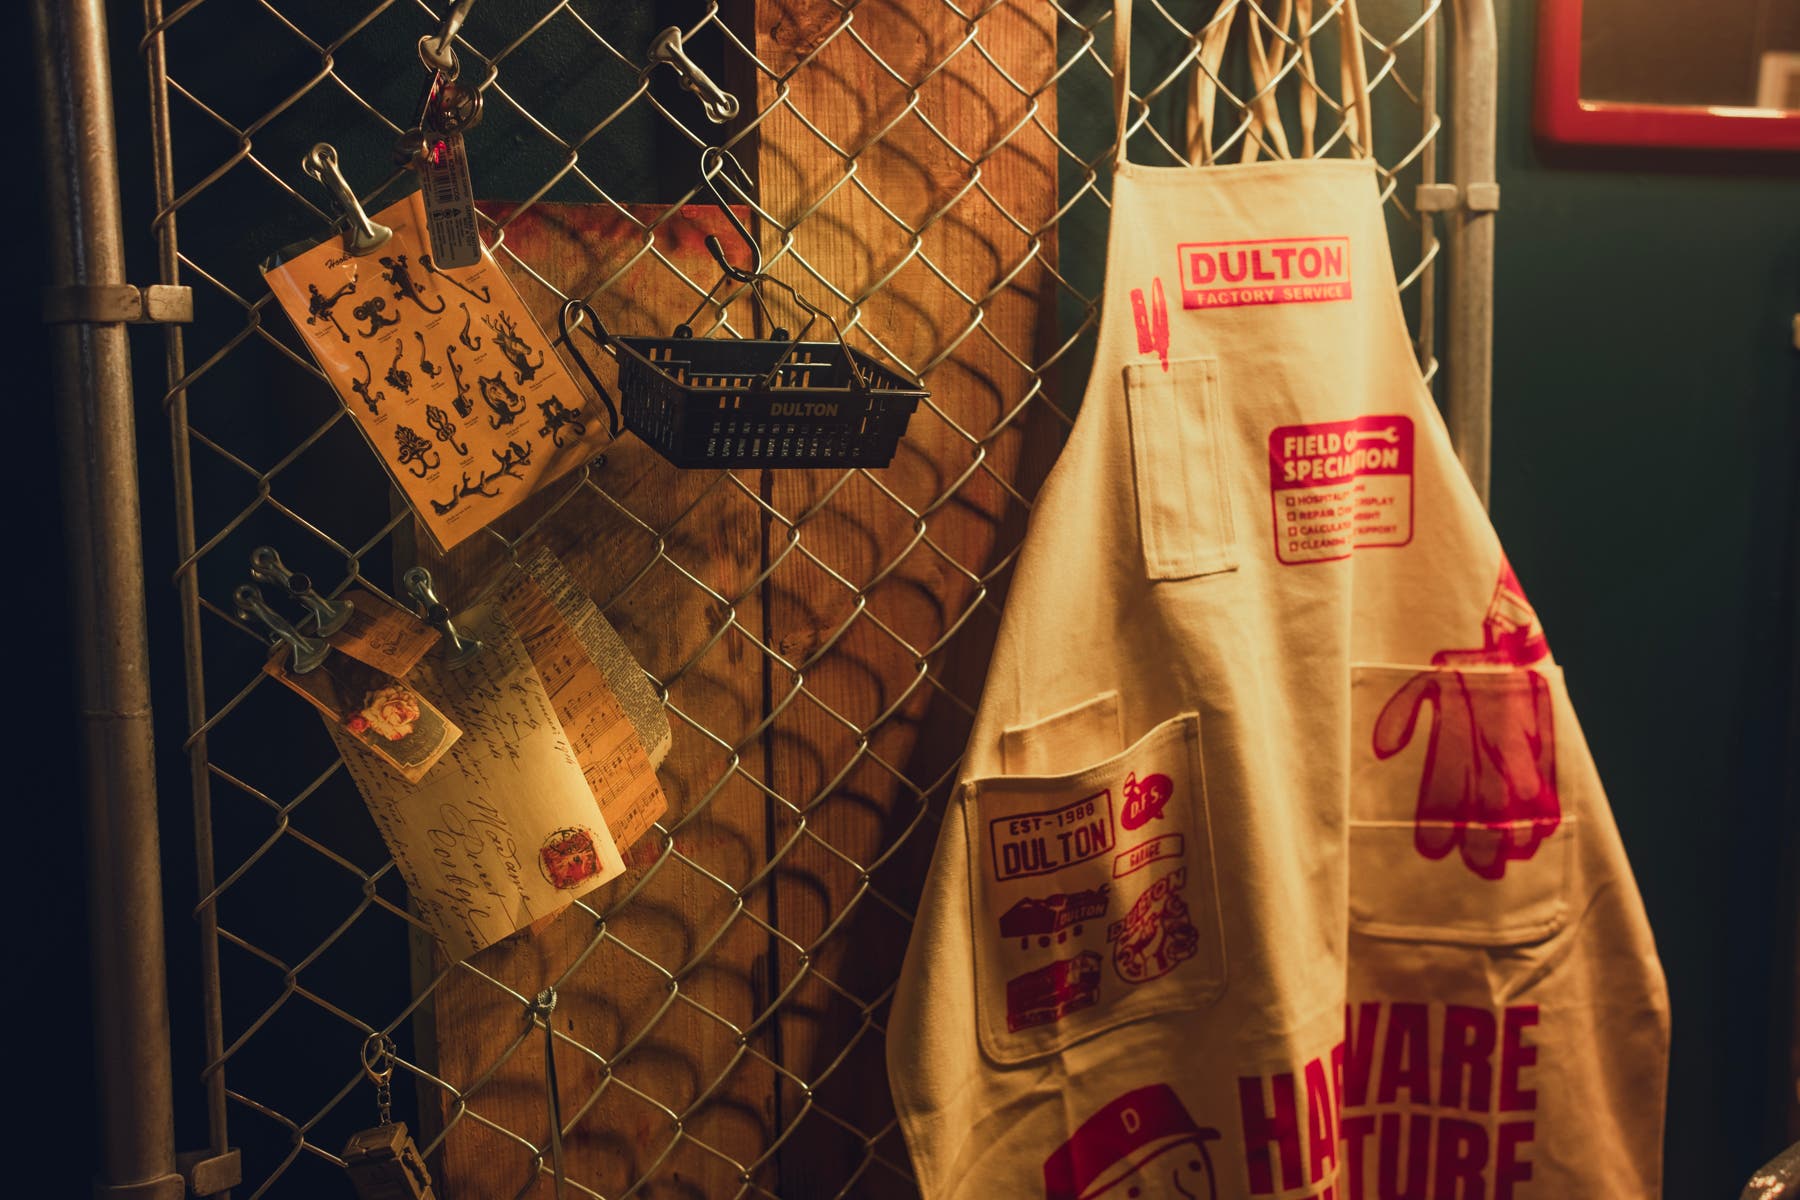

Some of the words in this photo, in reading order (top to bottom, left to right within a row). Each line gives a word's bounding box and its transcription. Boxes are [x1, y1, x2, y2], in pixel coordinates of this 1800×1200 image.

[1189, 246, 1343, 285] DULTON
[1197, 288, 1274, 306] FACTORY
[1282, 284, 1344, 301] SERVICE
[770, 403, 838, 417] DULTON
[1283, 432, 1341, 459] FIELD
[1009, 802, 1096, 836] EST-1988
[1002, 818, 1107, 876] DULTON
[1119, 1106, 1142, 1135] D
